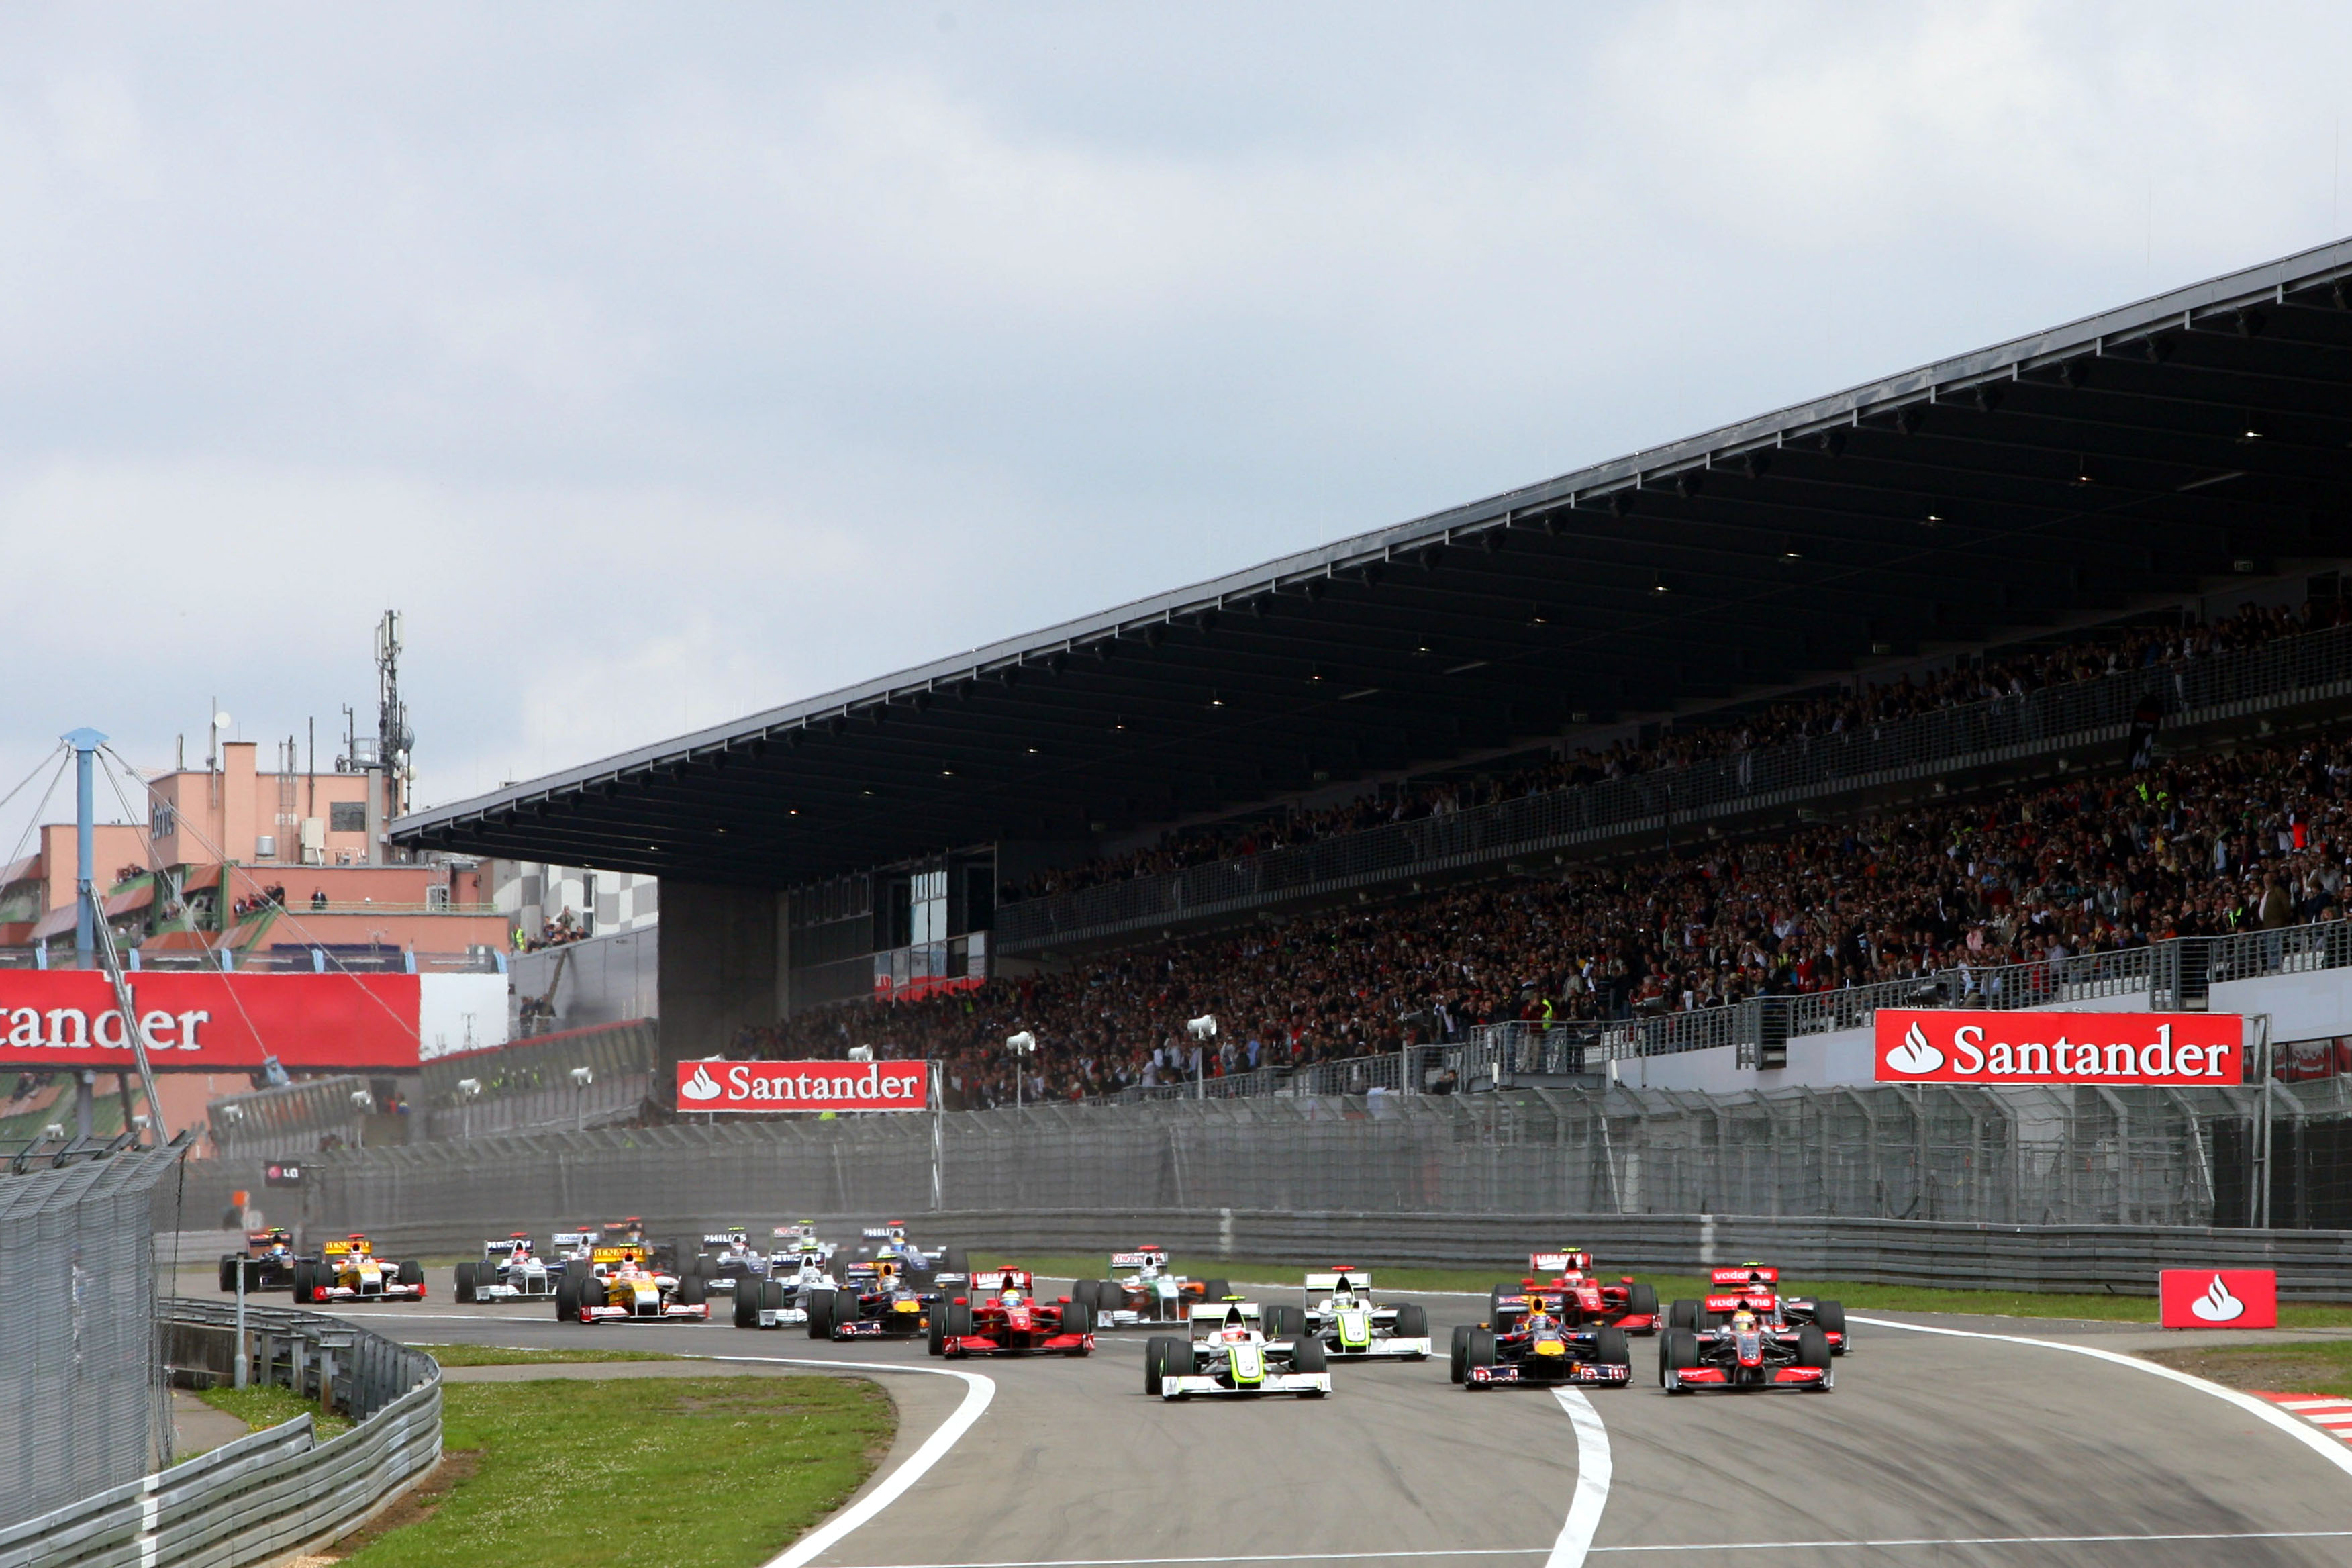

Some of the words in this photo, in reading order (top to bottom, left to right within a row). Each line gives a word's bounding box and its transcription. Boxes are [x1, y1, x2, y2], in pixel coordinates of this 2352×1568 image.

[1953, 1024, 2229, 1077] Santander
[728, 1063, 918, 1100] Santander
[283, 1167, 298, 1178] LG
[863, 1228, 904, 1236] PHILIS
[703, 1234, 746, 1242] PHILIS
[593, 1249, 642, 1257] RENAT
[772, 1253, 821, 1261] PETROS
[1714, 1270, 1772, 1280] vodafne
[1709, 1297, 1771, 1307] vodone
